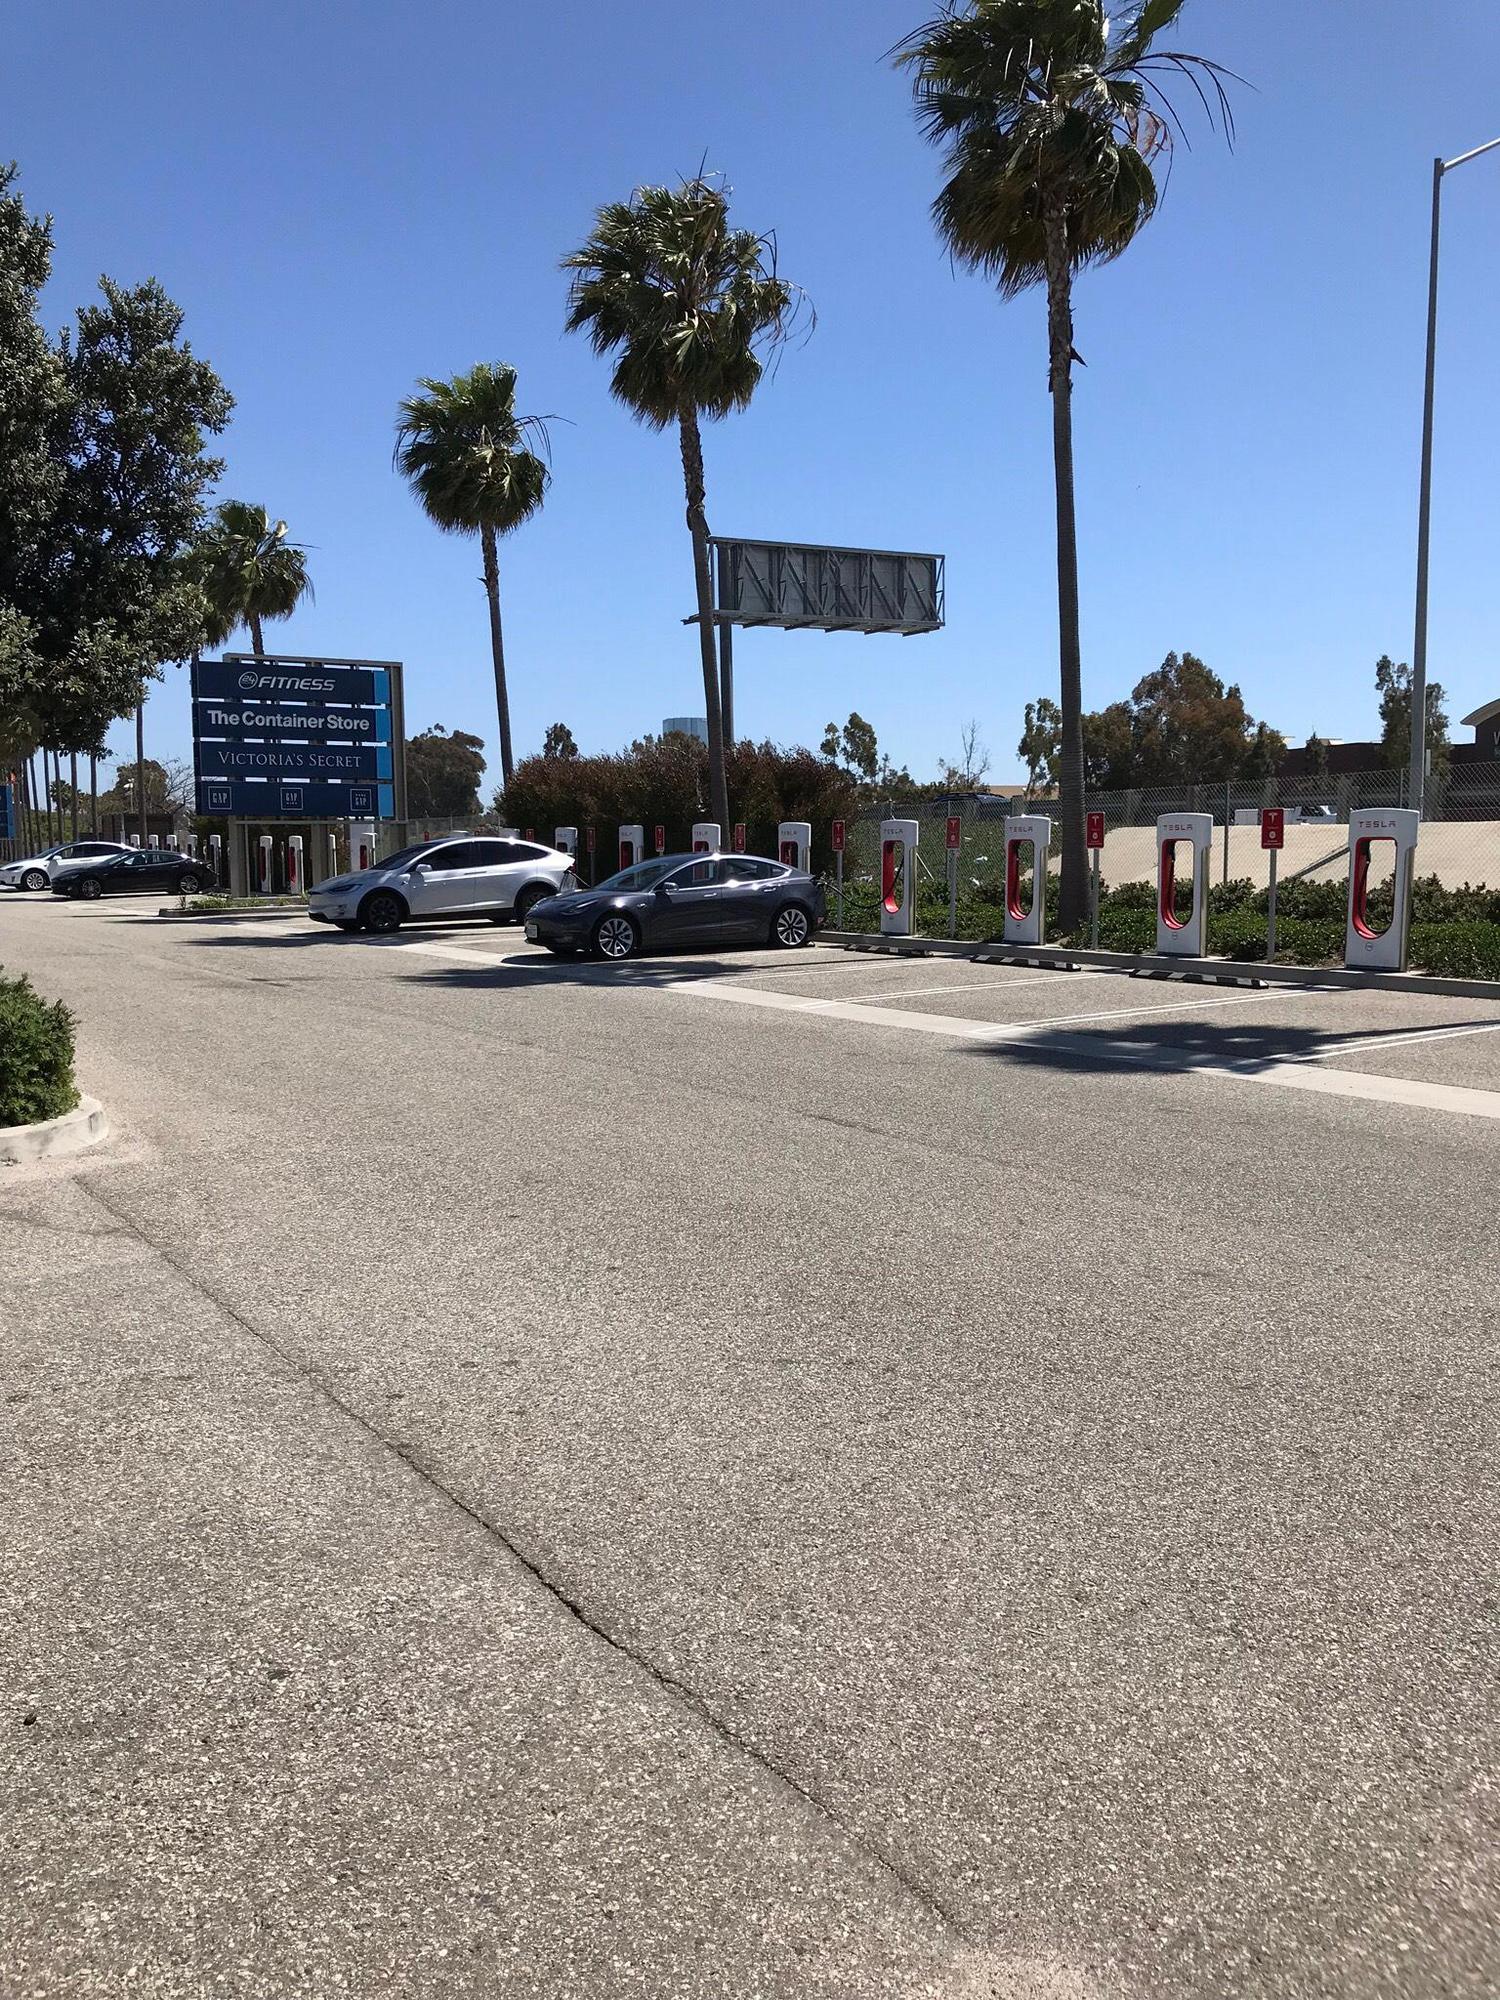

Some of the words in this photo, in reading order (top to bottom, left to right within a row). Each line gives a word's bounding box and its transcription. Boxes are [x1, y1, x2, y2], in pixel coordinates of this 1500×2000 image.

[258, 676, 336, 691] FITNESS
[207, 709, 240, 726] The
[242, 710, 325, 729] Container
[327, 714, 370, 731] Store
[218, 751, 304, 766] VICTORIA'S
[309, 753, 362, 768] SECRET
[212, 792, 228, 804] GAP
[1358, 820, 1396, 828] TESLA
